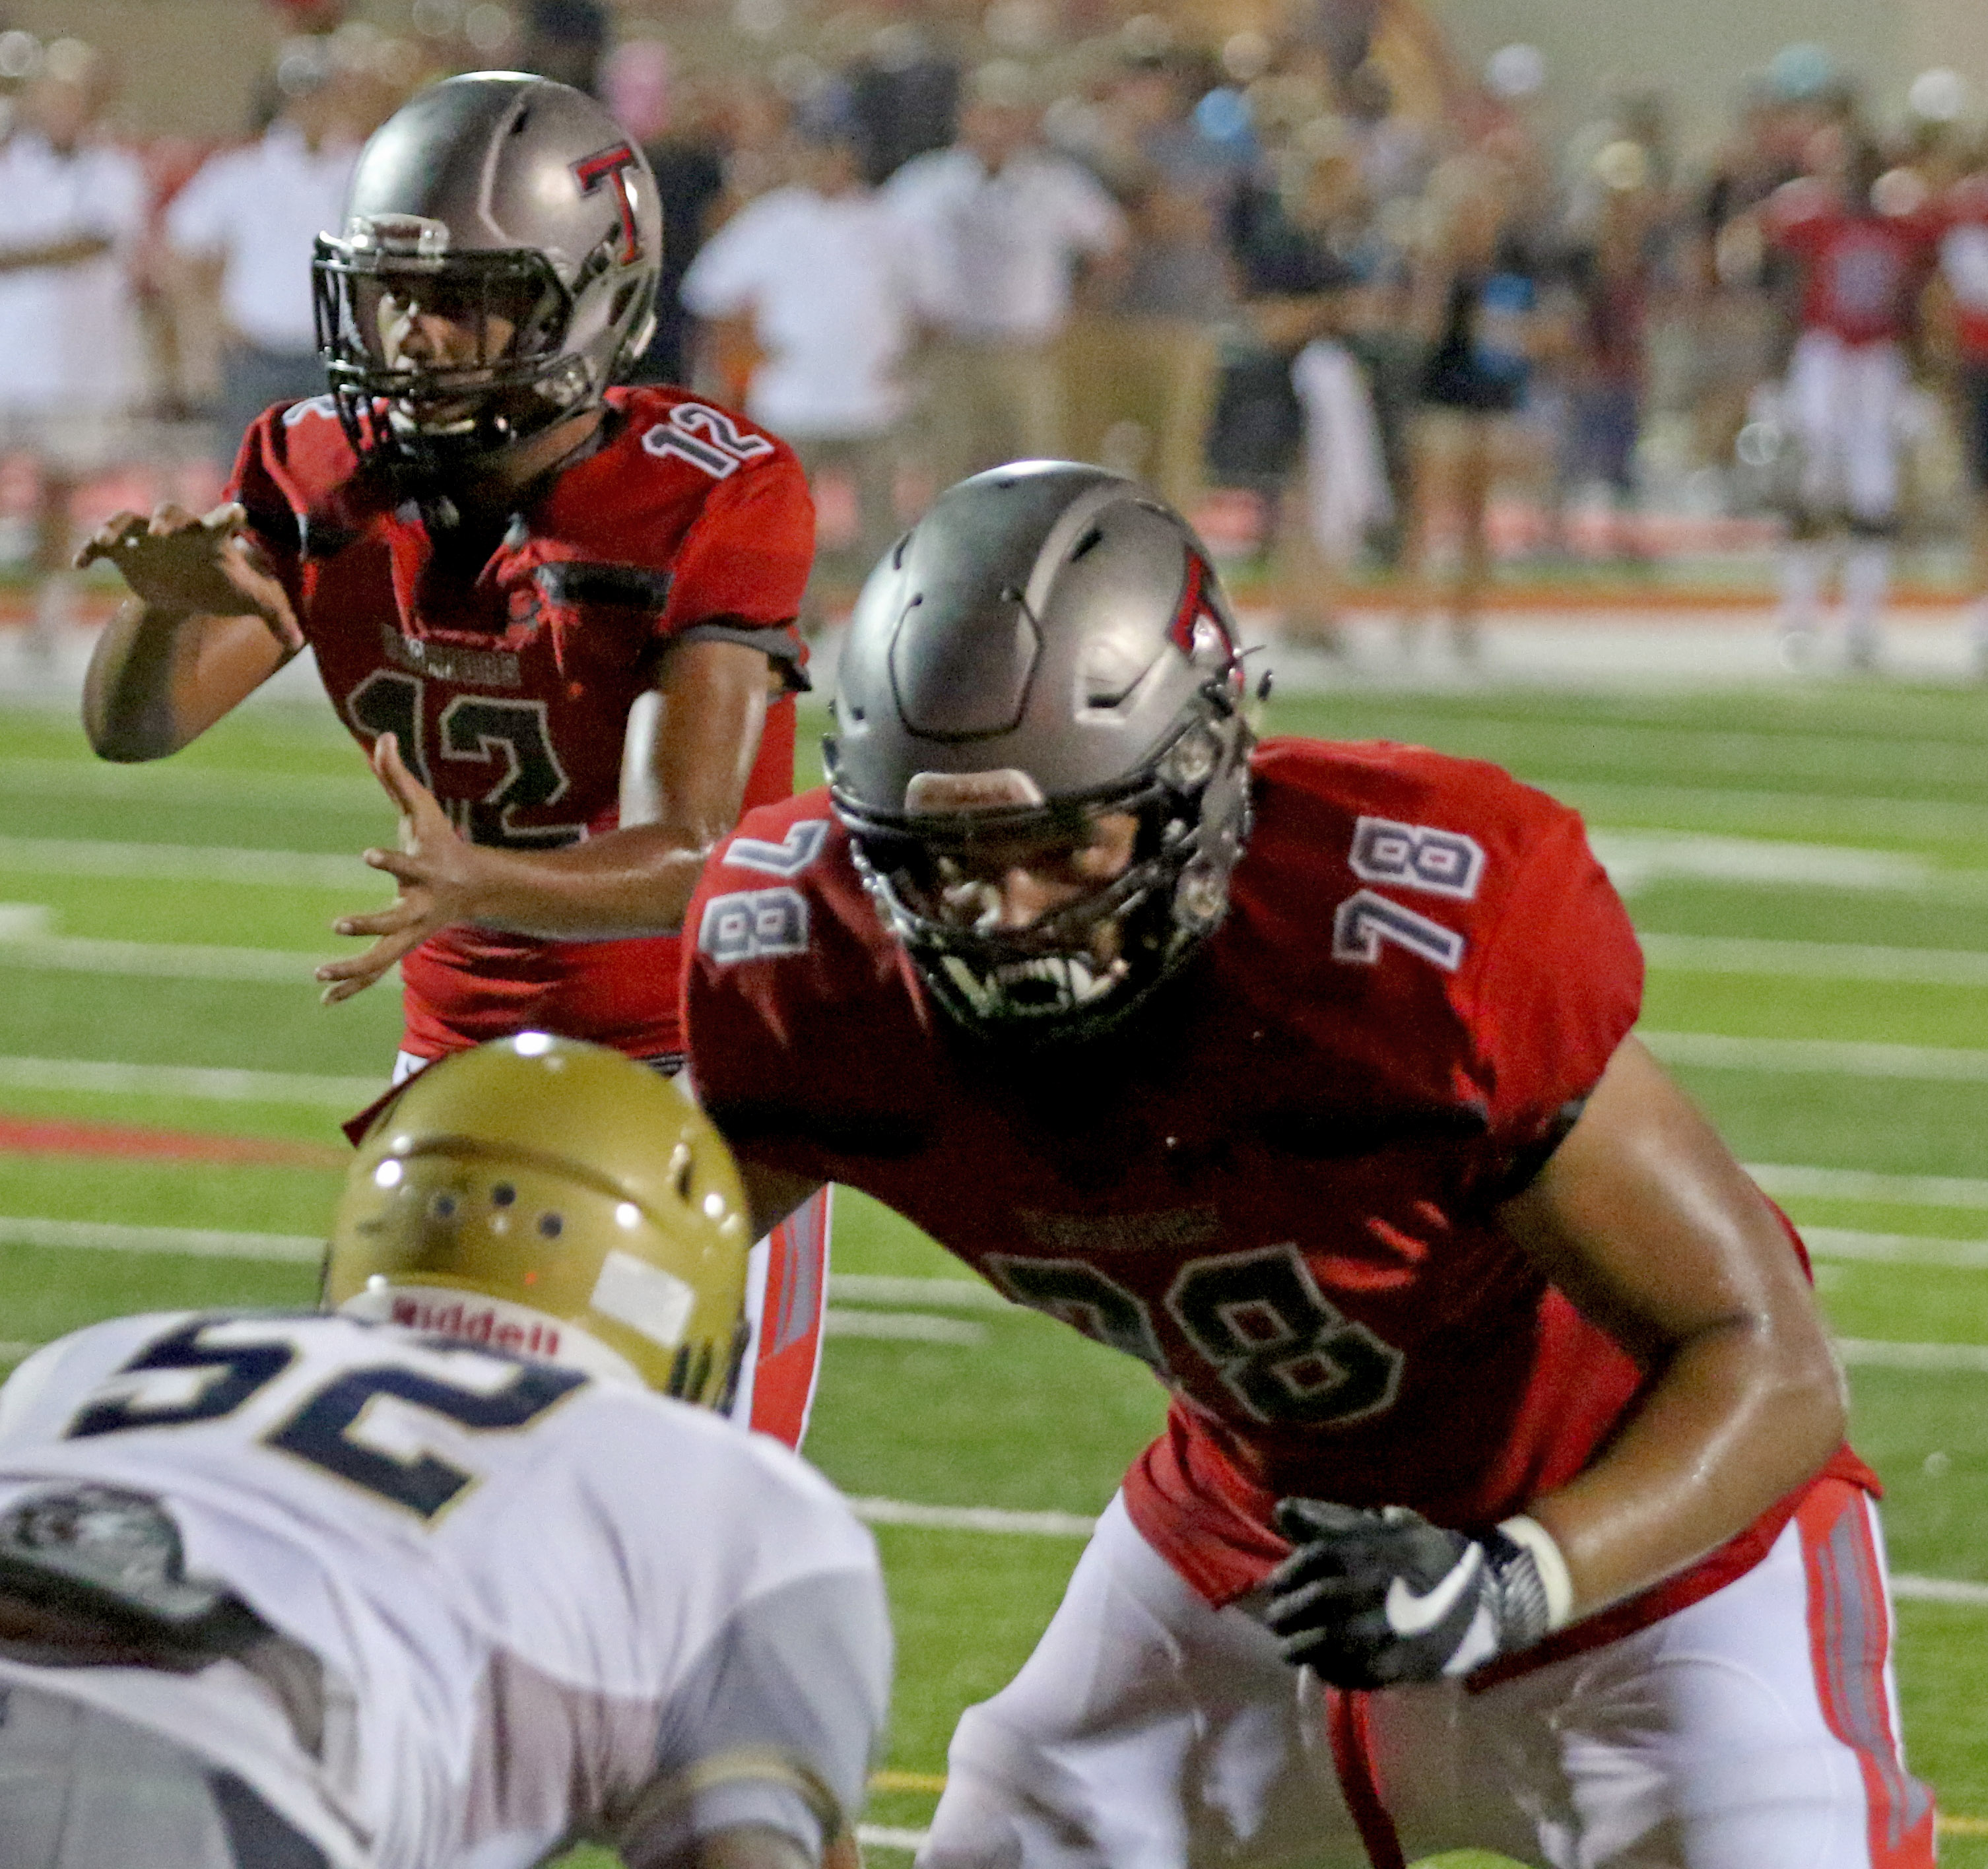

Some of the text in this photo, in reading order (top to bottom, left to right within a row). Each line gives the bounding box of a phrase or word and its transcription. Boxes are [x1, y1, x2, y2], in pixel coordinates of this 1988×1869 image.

[568, 141, 643, 265] T
[642, 403, 774, 479] 12
[346, 669, 590, 851] 12
[698, 819, 830, 963] 78
[1332, 816, 1485, 972] 78
[391, 1295, 560, 1358] Riddell
[59, 1310, 593, 1523] 52
